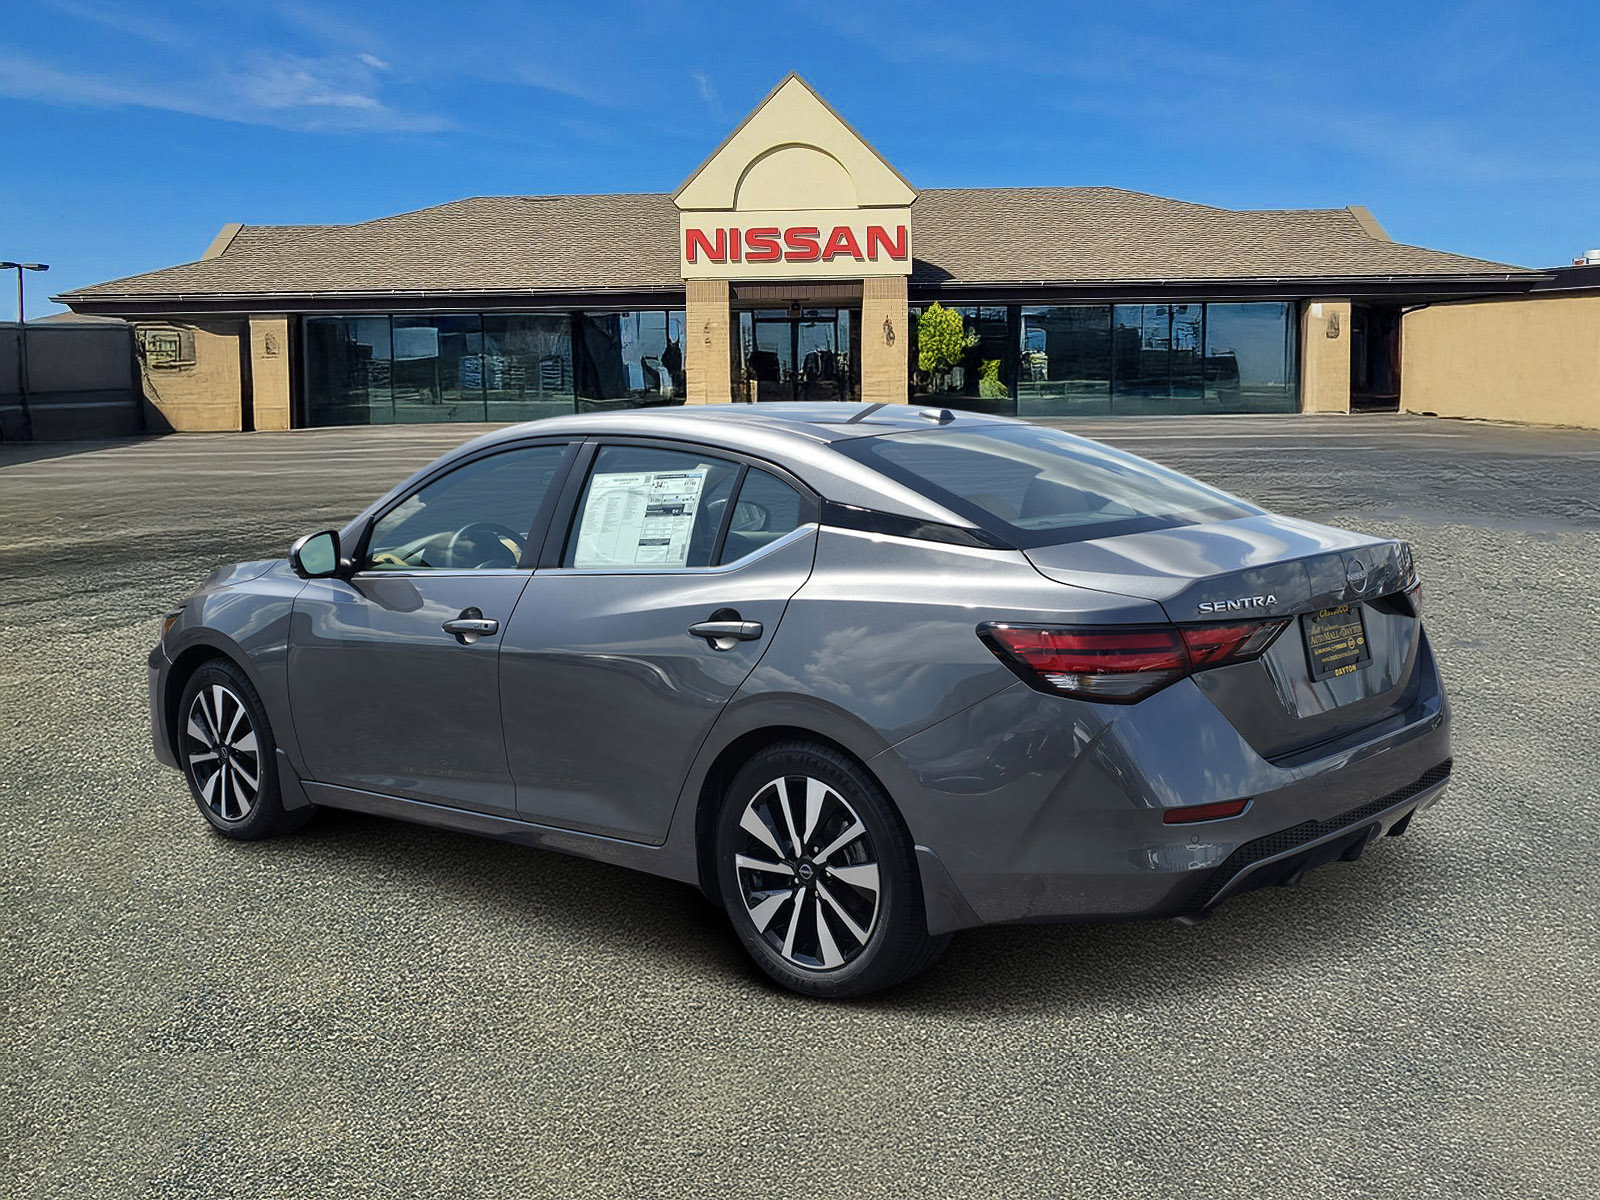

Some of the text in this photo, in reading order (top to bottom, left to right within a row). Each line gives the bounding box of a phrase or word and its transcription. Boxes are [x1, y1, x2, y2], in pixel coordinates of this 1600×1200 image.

[685, 225, 907, 264] NISSAN
[1198, 594, 1278, 614] SENTRA
[1335, 664, 1357, 676] DAYTON
